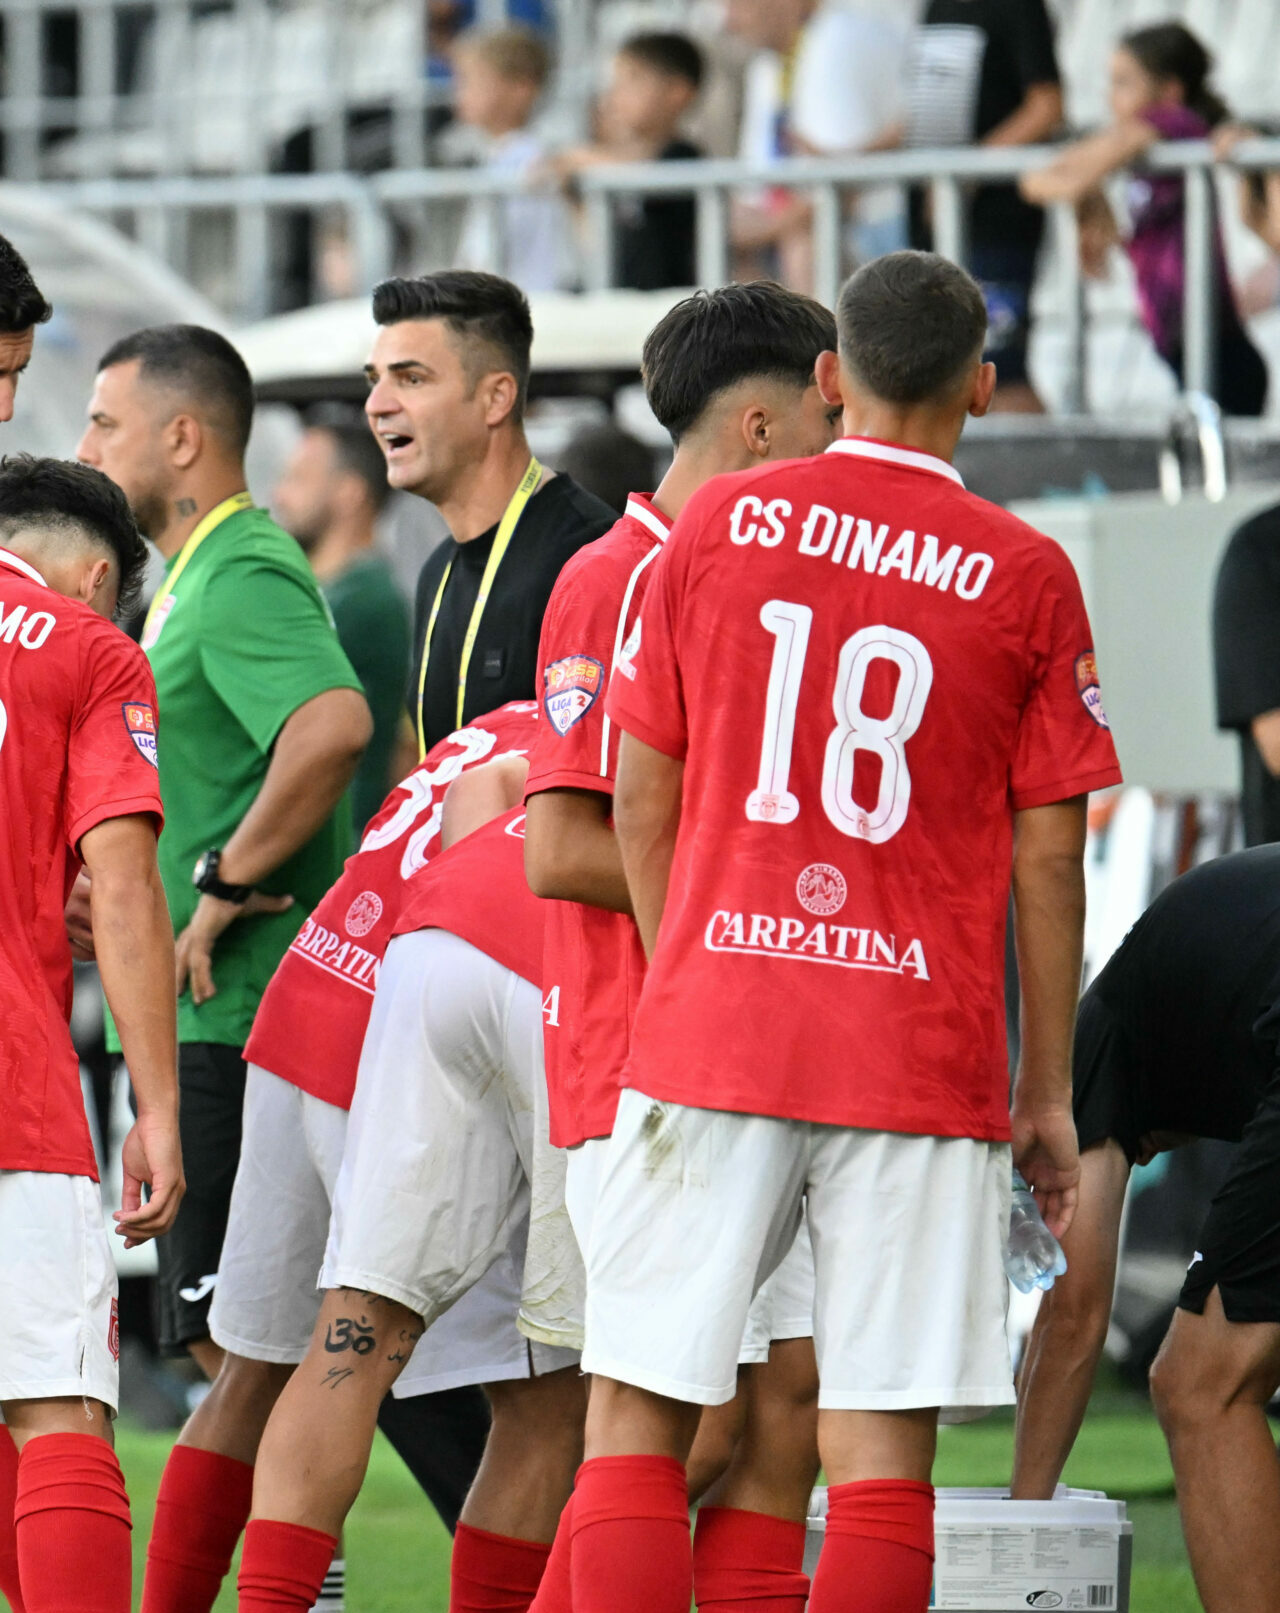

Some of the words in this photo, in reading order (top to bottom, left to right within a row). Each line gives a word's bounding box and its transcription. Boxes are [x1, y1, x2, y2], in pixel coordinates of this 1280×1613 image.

[729, 496, 793, 548] CS
[797, 504, 994, 600] DINAMO
[551, 697, 572, 712] LIGA
[577, 695, 587, 708] 2
[745, 599, 934, 845] 18
[703, 909, 932, 982] CARPATINA
